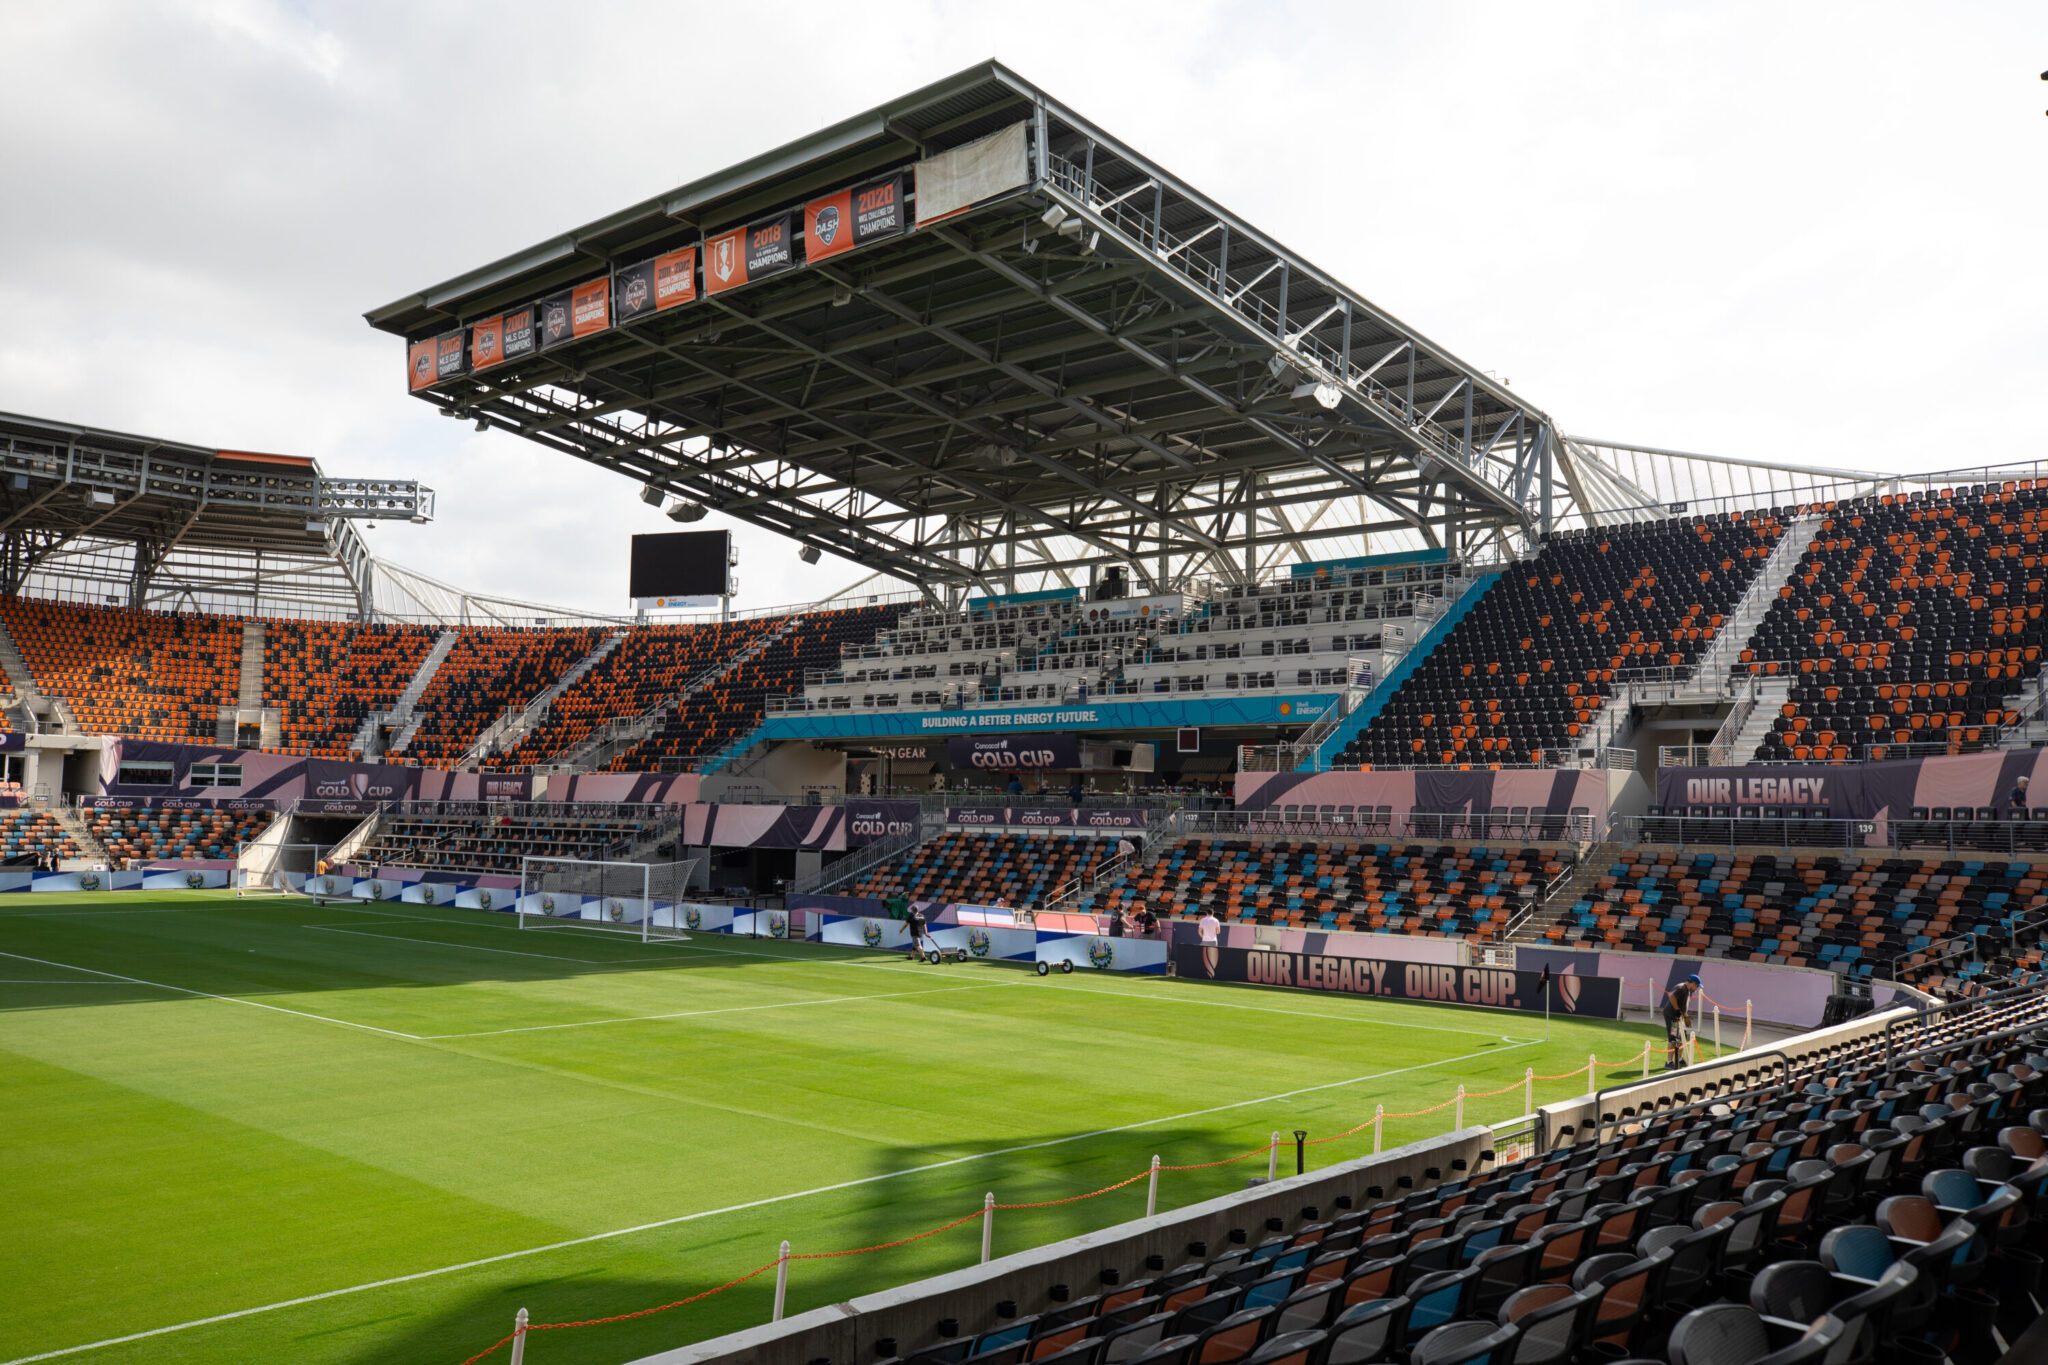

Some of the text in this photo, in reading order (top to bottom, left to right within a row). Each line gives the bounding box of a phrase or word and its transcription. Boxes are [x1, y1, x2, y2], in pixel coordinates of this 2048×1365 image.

[859, 184, 893, 213] 2020
[816, 218, 838, 236] DASH
[860, 215, 895, 236] CHAMPIONS
[753, 224, 781, 248] 2018
[749, 250, 787, 270] CHAMPIONS
[658, 279, 690, 298] CHAMPIONS
[506, 310, 530, 334] 2007
[576, 308, 604, 325] CHAMPIONS
[506, 328, 531, 343] MLS CUP
[506, 338, 531, 354] CHAMPIONS
[449, 352, 460, 362] CUP
[1296, 706, 1323, 715] ENERGY
[922, 711, 1098, 728] BUILDING A BETTER ENERGY FUTURE.
[898, 747, 927, 758] GEAR
[975, 742, 1000, 750] Concacaf
[971, 750, 1055, 767] GOLD CUP
[316, 786, 392, 797] GOLD CUP
[487, 781, 498, 794] OUR
[1687, 777, 1829, 804] OUR LEGACY.
[958, 814, 994, 823] GOLD CUP
[1022, 816, 1060, 824] GOLD CUP
[1090, 816, 1131, 826] GOLD CUP
[852, 821, 912, 836] GOLD CUP
[1858, 824, 1873, 833] 139
[1247, 951, 1520, 1007] OUR LEGACY. OUR CUP.
